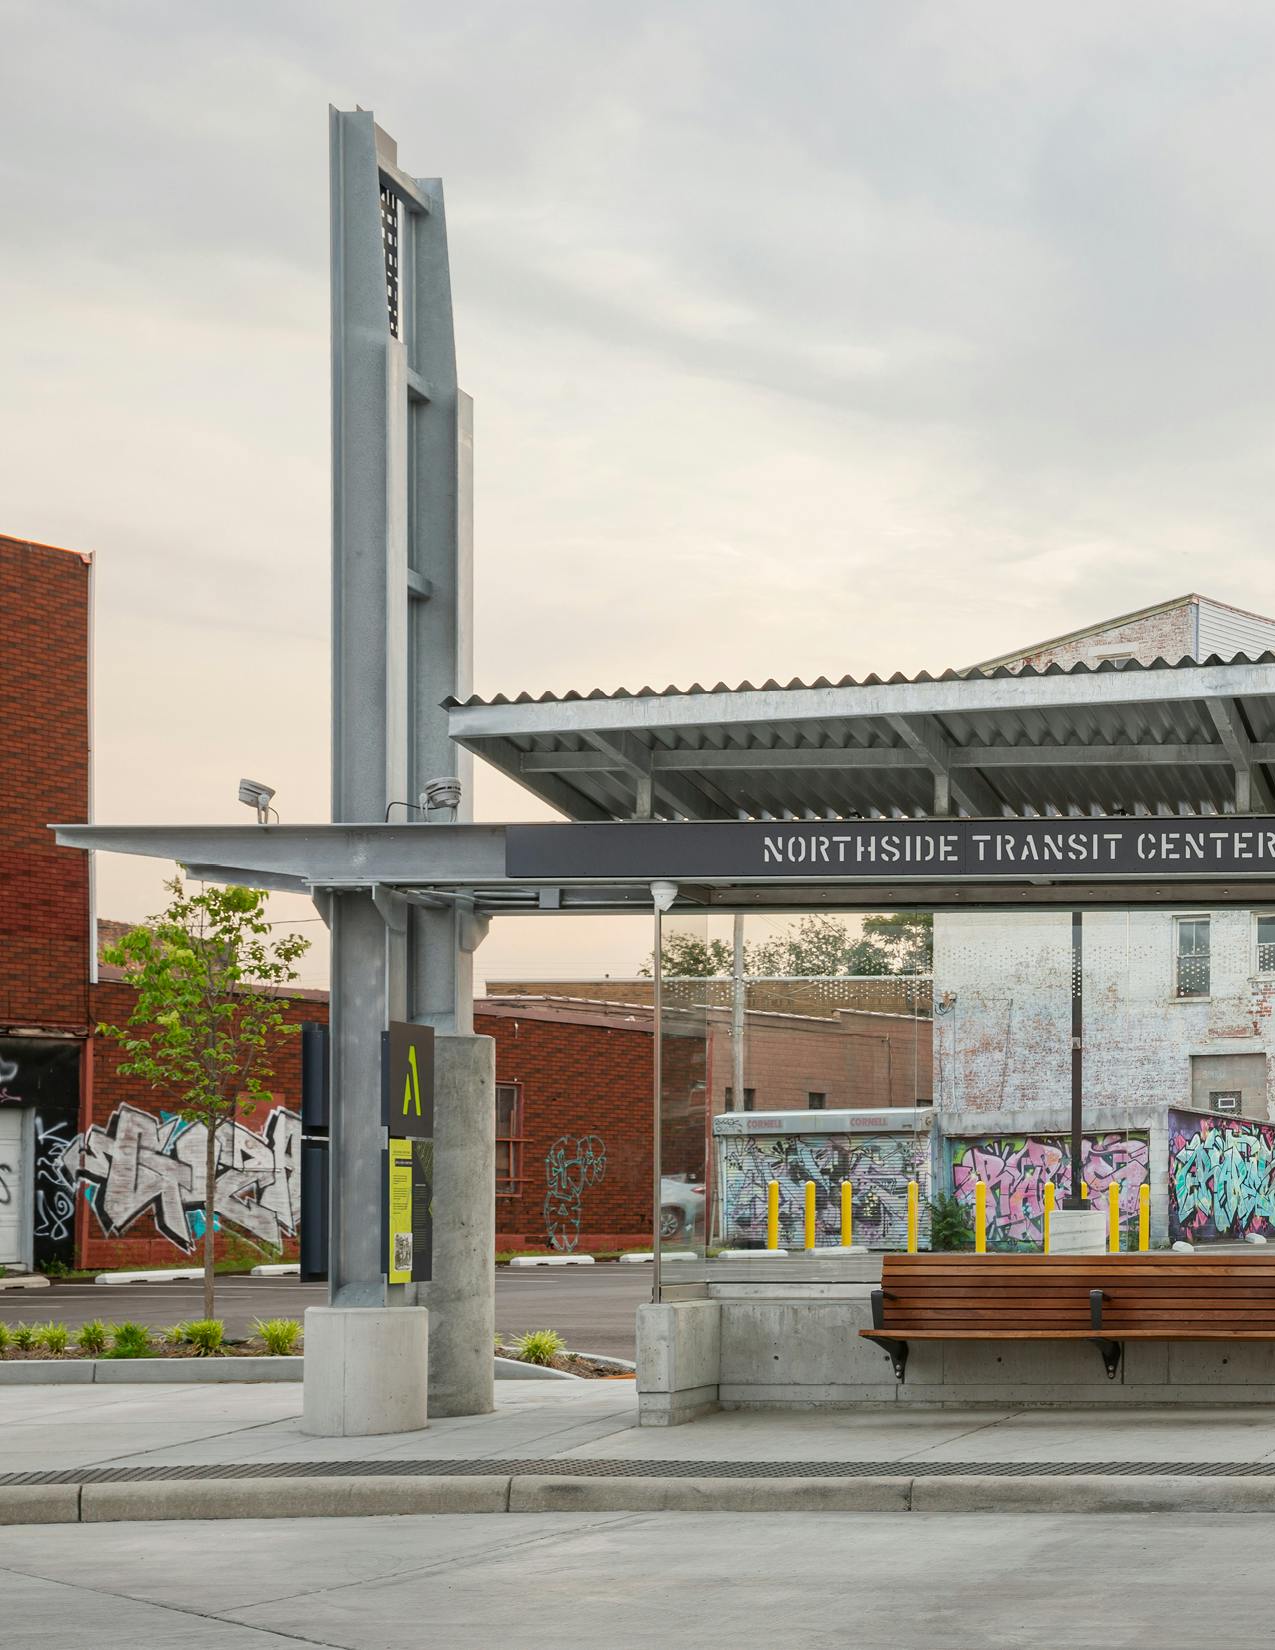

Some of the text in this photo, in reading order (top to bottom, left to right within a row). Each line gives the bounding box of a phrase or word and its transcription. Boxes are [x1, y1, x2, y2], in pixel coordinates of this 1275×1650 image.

[764, 835, 958, 862] NORTHSIDE
[972, 833, 1122, 860] TRANSIT
[746, 1119, 783, 1129] CORNELL
[850, 1117, 888, 1127] CORNELL
